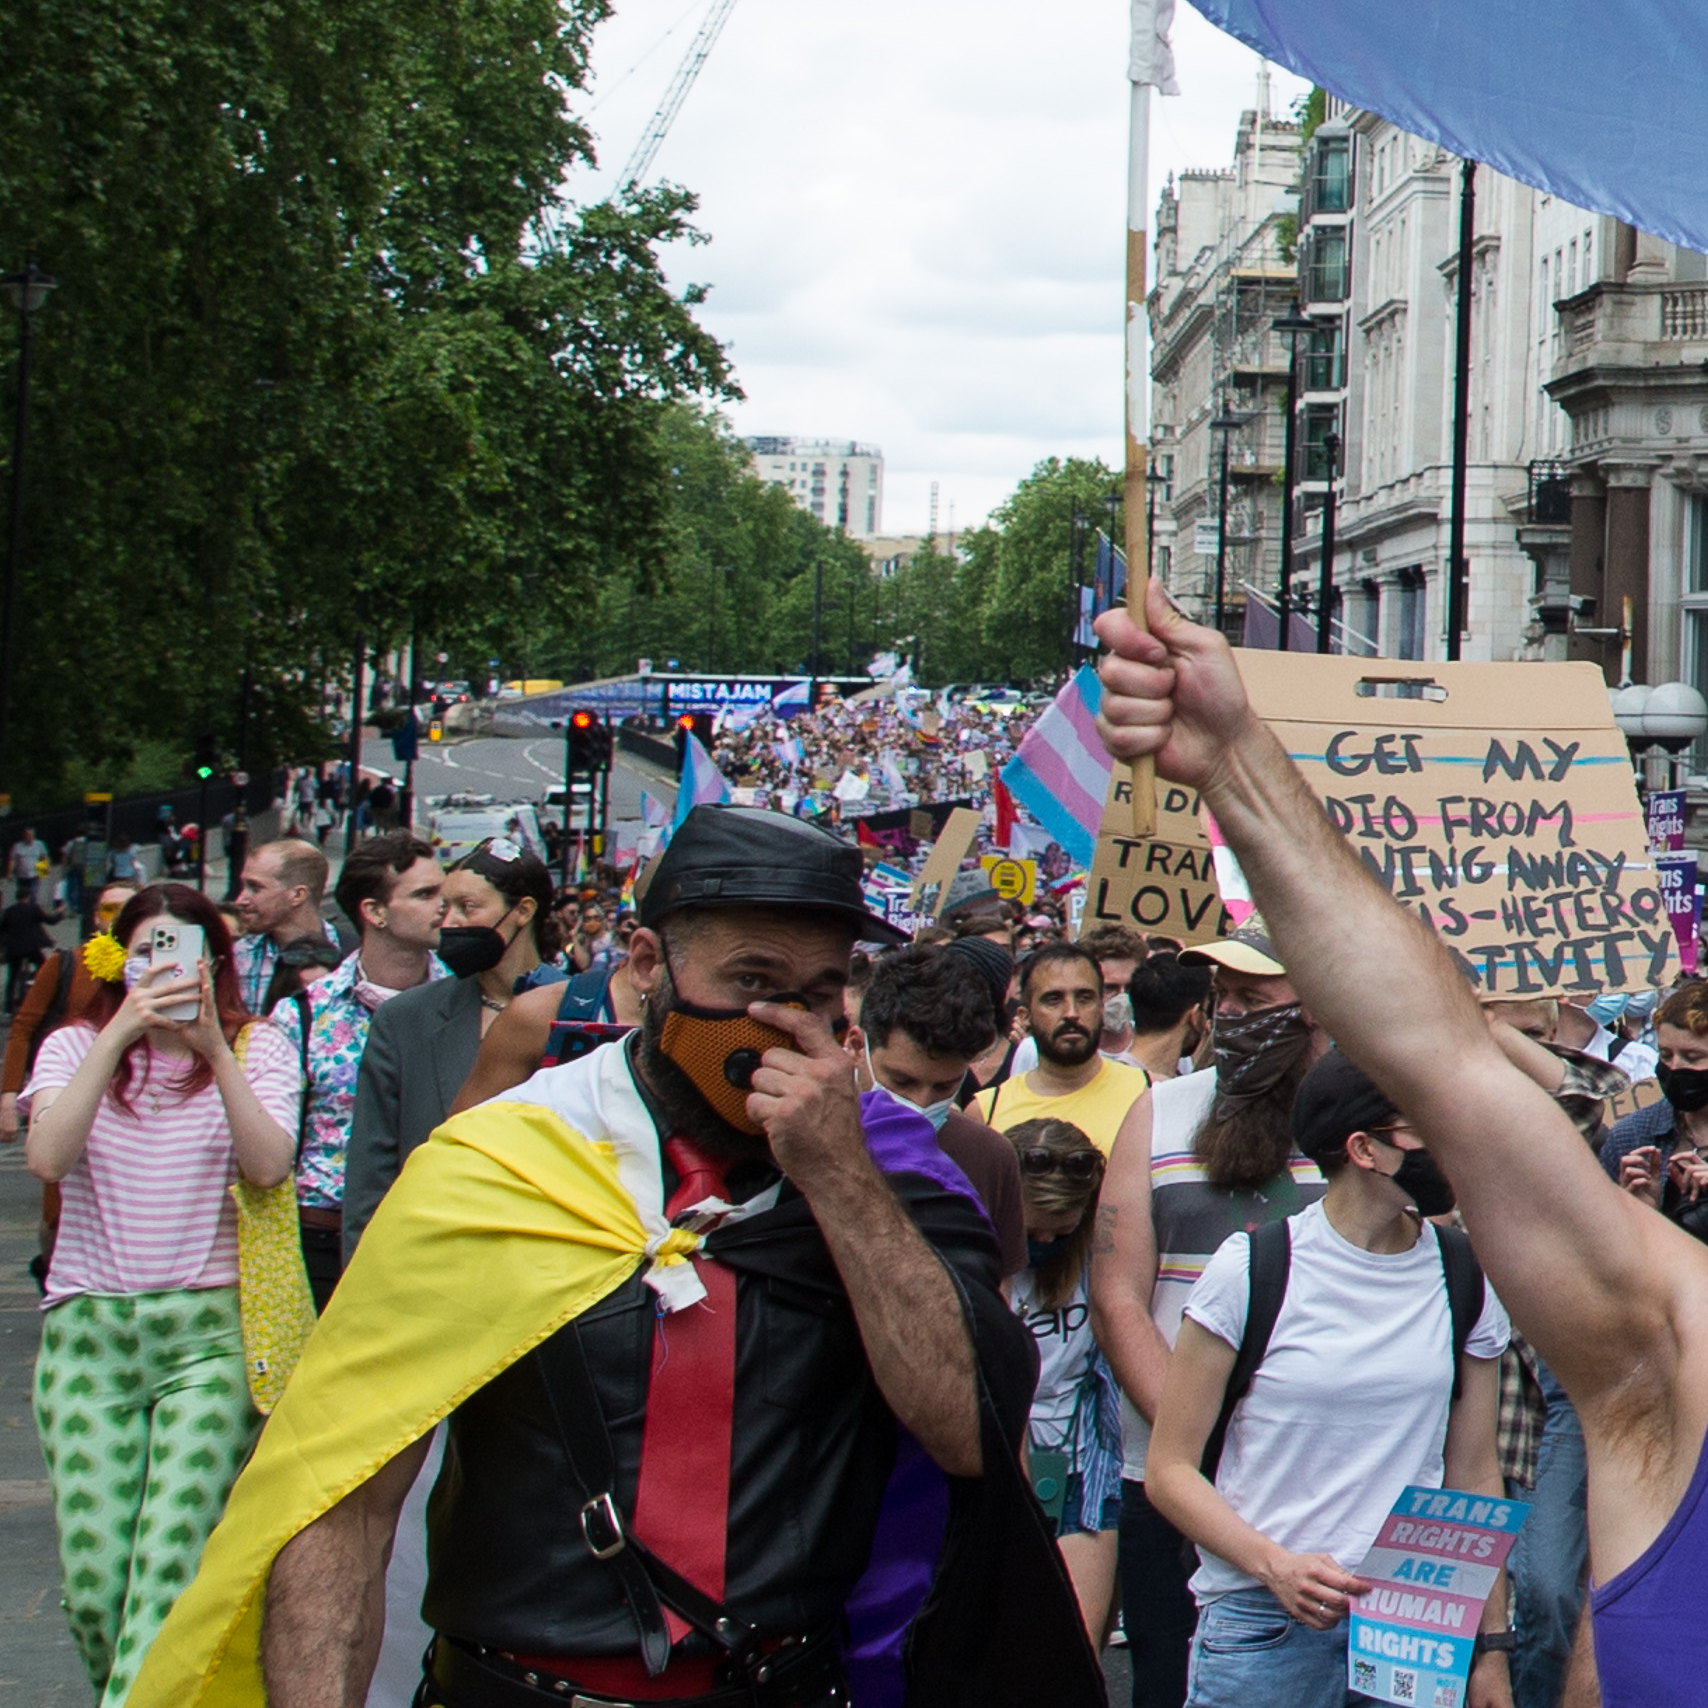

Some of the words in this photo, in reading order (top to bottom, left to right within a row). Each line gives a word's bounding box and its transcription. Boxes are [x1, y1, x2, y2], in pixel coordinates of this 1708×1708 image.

[668, 682, 773, 701] MISTAJAM
[1326, 730, 1424, 777] GET
[1481, 736, 1581, 784] MY
[1114, 780, 1200, 817] RDI
[1649, 793, 1678, 816] Trans
[1436, 795, 1577, 848] FROM
[1649, 815, 1684, 841] Rights
[1506, 845, 1627, 900] AWAY
[1398, 887, 1662, 939] IS-HETERO
[1409, 1492, 1513, 1528] TRANS
[1389, 1521, 1496, 1559] RIGHTS
[1392, 1557, 1457, 1588] ARE
[1359, 1587, 1467, 1628] HUMAN
[1357, 1625, 1456, 1669] RIGHTS
